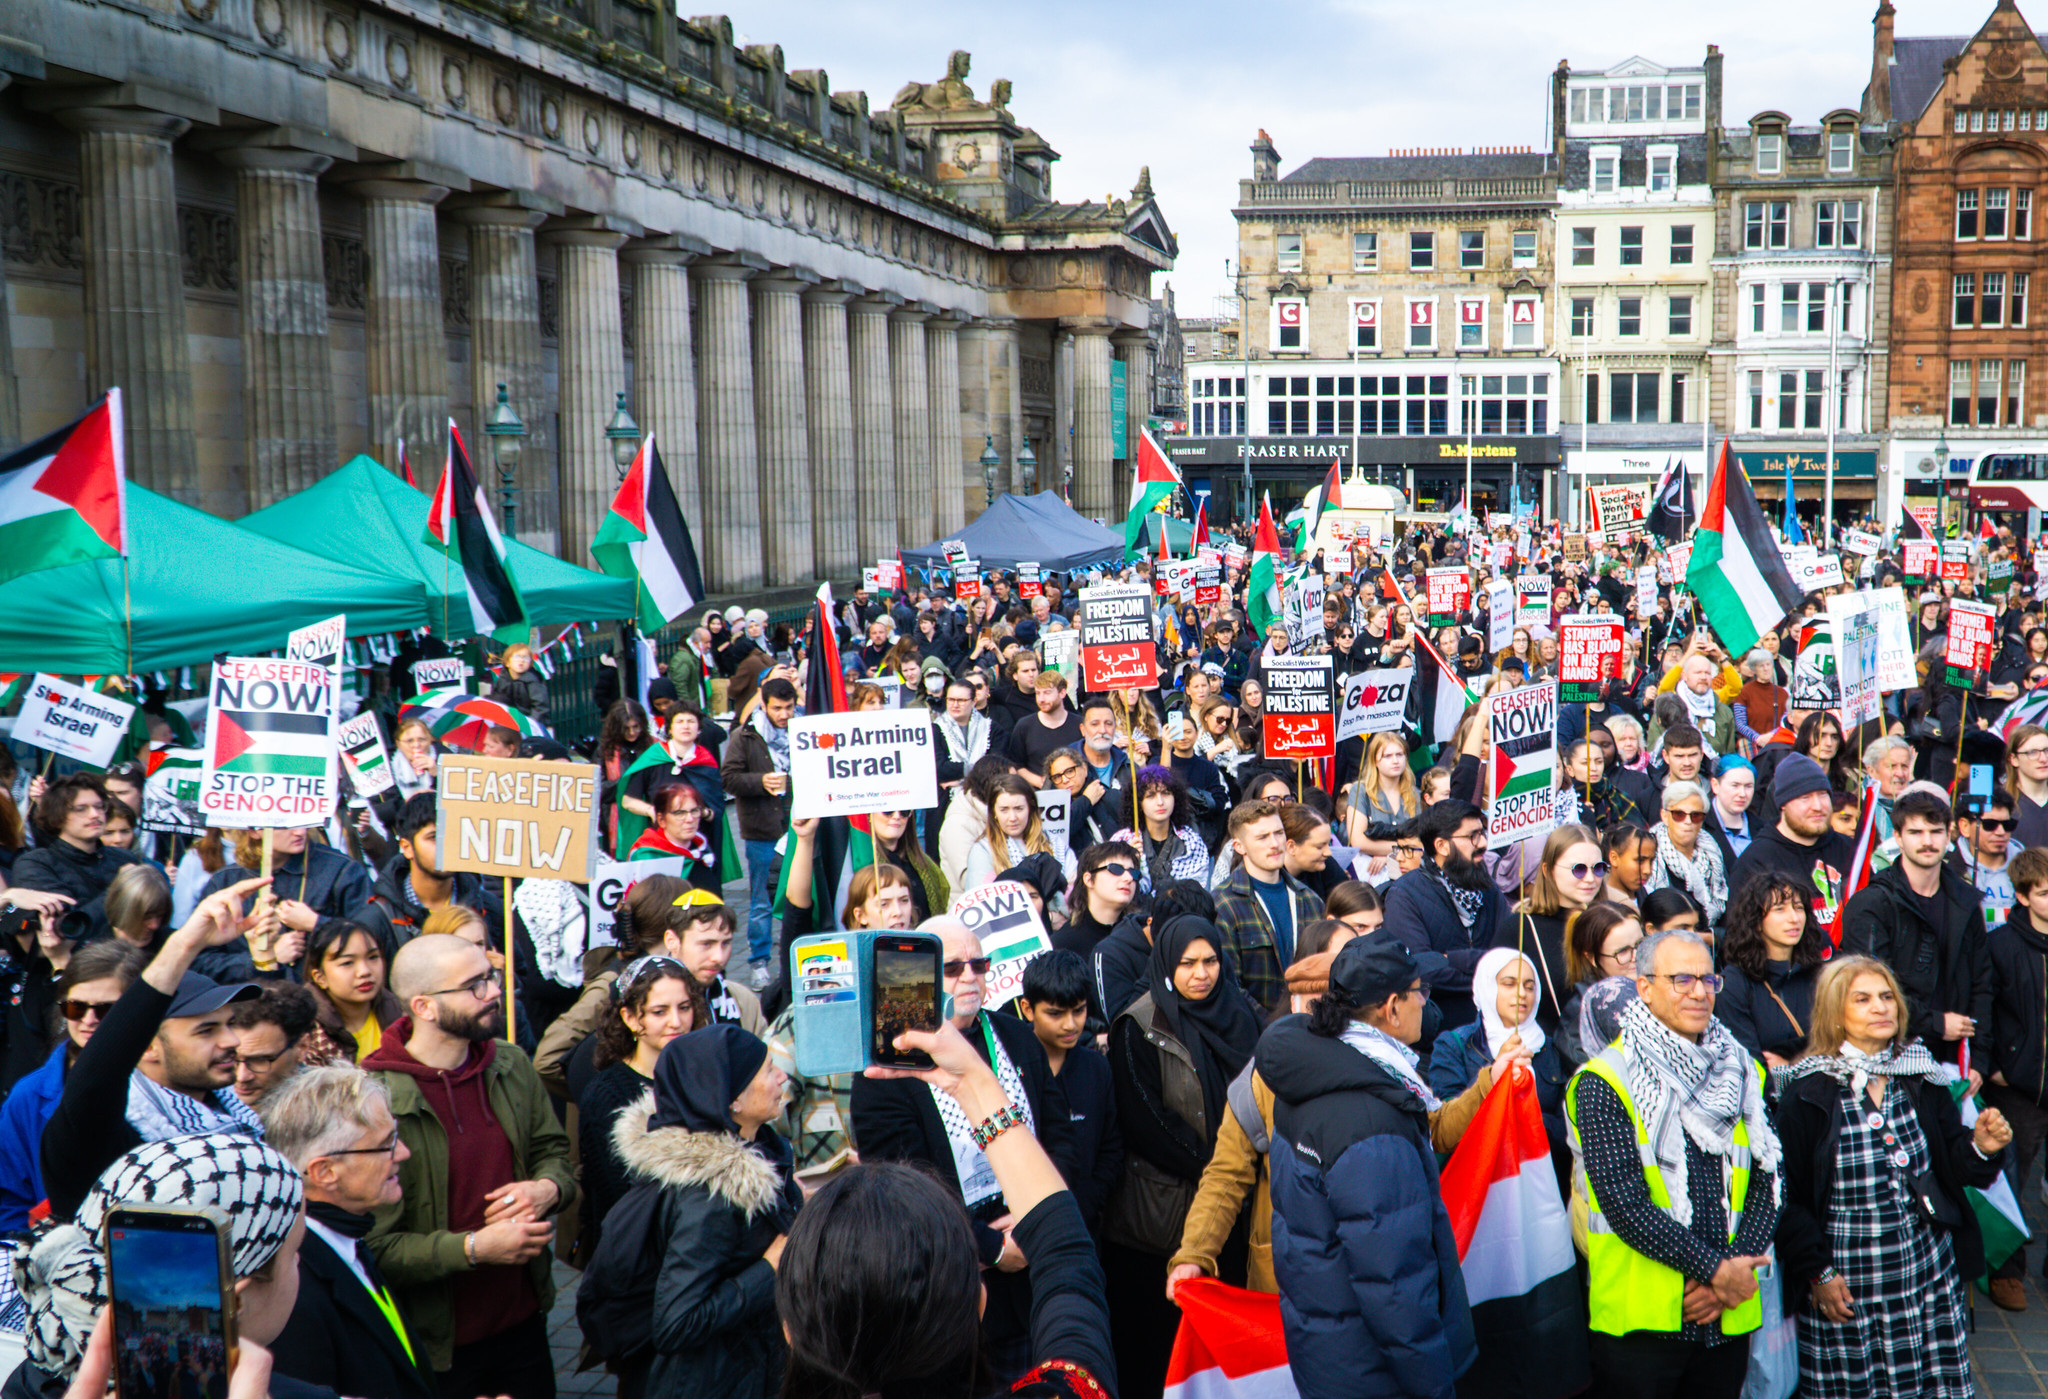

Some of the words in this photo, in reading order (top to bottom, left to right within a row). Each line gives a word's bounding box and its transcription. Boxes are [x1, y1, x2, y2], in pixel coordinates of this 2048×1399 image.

[1237, 445, 1299, 457] FRASER
[1303, 445, 1349, 457] HART
[1622, 459, 1650, 468] Three
[1762, 459, 1785, 471] Isle
[1801, 459, 1840, 471] Twed
[1601, 491, 1645, 505] Socialist
[1602, 502, 1641, 514] Workers
[1604, 511, 1629, 523] Party
[1853, 534, 1878, 548] Gza
[1802, 561, 1838, 577] Gza
[1429, 576, 1461, 586] STARMER
[1445, 584, 1468, 593] BLOOD
[1518, 581, 1550, 591] NOW!
[1089, 589, 1117, 598] Socialist
[1117, 588, 1140, 596] Worker
[1302, 587, 1322, 611] Gza
[1086, 599, 1145, 619] FREEDOM
[1430, 602, 1453, 612] HANDS
[1111, 617, 1121, 625] for
[1951, 611, 1986, 629] STARMER
[1084, 623, 1150, 644] PALESTINE
[1563, 626, 1612, 641] STARMER
[1843, 621, 1878, 643] PALESTINE
[1950, 624, 1965, 638] HAS
[1965, 627, 1991, 645] BLOOD
[289, 629, 340, 661] NOW!
[1563, 640, 1585, 653] HAS
[1587, 638, 1621, 653] BLOOD
[1949, 637, 1959, 650] ON
[1960, 640, 1975, 654] HIS
[1097, 647, 1140, 666] الحرية
[1562, 654, 1578, 667] ON
[1581, 653, 1599, 667] HIS
[1947, 650, 1974, 668] HANDS
[217, 661, 331, 688] CEASEFIRE
[1094, 663, 1148, 683] لفلسطين
[1268, 671, 1325, 688] FREEDOM
[1562, 666, 1598, 680] HANDS
[1561, 683, 1579, 693] FREE
[1945, 675, 1972, 690] PALESTINE
[214, 677, 332, 716] NOW!
[1292, 688, 1302, 696] for
[1346, 683, 1406, 711] Gza
[1492, 686, 1553, 714] CEASEFIRE
[1561, 692, 1598, 702] PALESTINE
[1846, 689, 1875, 709] APARHEID
[35, 684, 68, 708] Stp
[69, 697, 124, 728] Arming
[1266, 695, 1329, 712] PALESTINE
[44, 706, 99, 738] Israel
[1366, 709, 1401, 721] massacre
[1492, 701, 1554, 743] NOW!
[1277, 718, 1319, 735] الحرية
[796, 731, 846, 752] Stp
[851, 724, 927, 747] Arming
[1273, 733, 1326, 750] لفلسطين
[827, 750, 902, 779] Israel
[211, 773, 275, 793] STOP
[282, 777, 326, 796] THE
[442, 766, 594, 812] CEASEFIRE
[881, 789, 909, 797] coalition
[204, 791, 329, 814] GENOCIDE
[1494, 796, 1529, 818] STOP
[1530, 788, 1552, 806] THE
[1490, 803, 1554, 835] GENOCIDE
[460, 817, 572, 872] NOW
[954, 883, 1022, 915] ASEFIRE
[960, 890, 1029, 928] OW!
[597, 923, 613, 933] Sto
[985, 963, 1007, 983] OP
